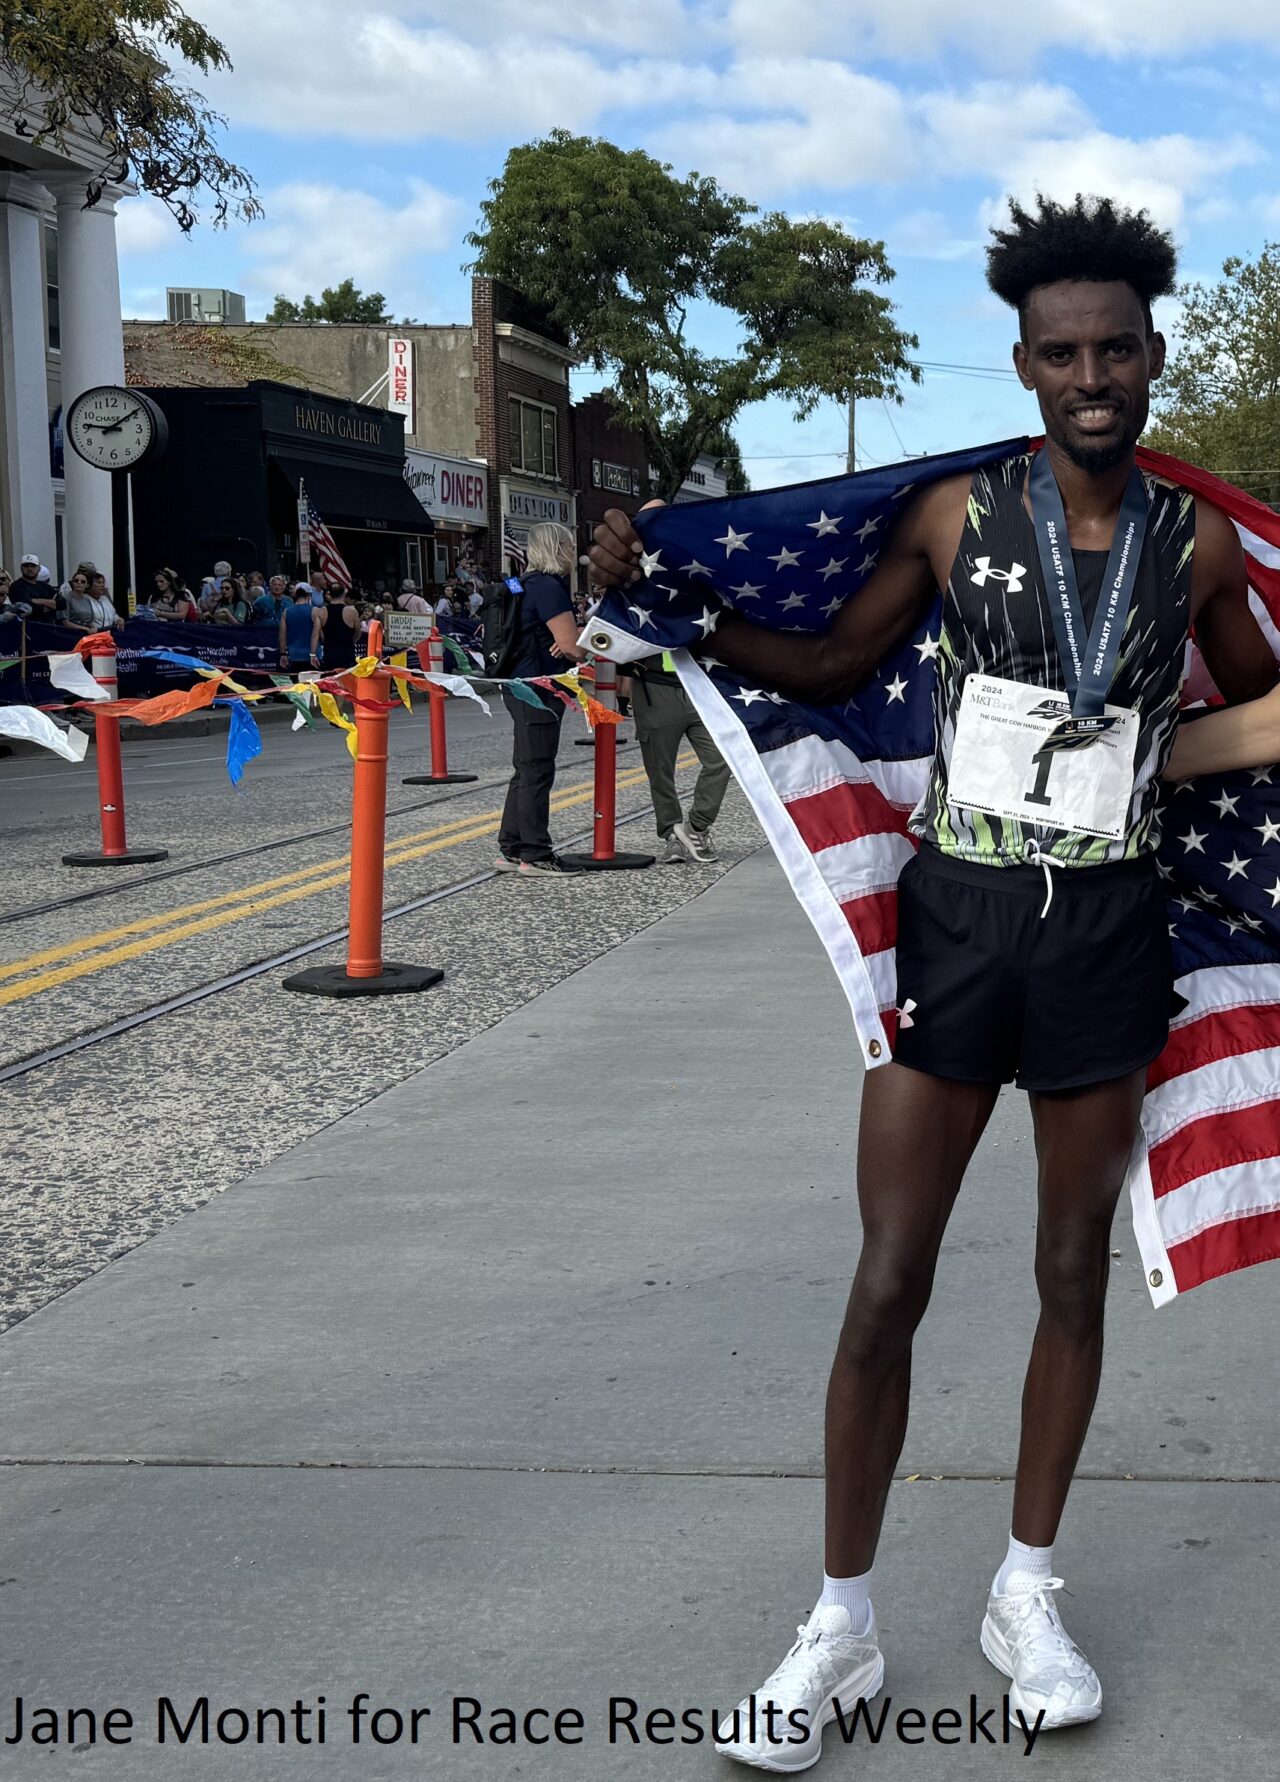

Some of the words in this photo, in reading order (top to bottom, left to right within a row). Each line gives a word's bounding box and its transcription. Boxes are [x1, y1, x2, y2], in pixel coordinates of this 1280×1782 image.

[394, 341, 407, 402] DINER
[95, 401, 102, 410] 11
[105, 397, 118, 408] 12
[123, 402, 127, 410] 1
[84, 411, 95, 420] 10
[135, 423, 143, 434] 3
[295, 405, 335, 436] HAVEN
[337, 415, 382, 445] GALLERY
[86, 438, 93, 446] 8
[135, 438, 141, 446] 4
[98, 446, 104, 455] 7
[110, 448, 118, 460] 6
[125, 448, 131, 456] 5
[441, 470, 484, 510] DINER
[1046, 521, 1058, 545] 2024
[1051, 547, 1064, 577] USATF
[1113, 521, 1135, 589] Championships
[1057, 580, 1067, 592] 10
[1060, 593, 1071, 609] KM
[1109, 590, 1120, 606] KM
[1106, 607, 1116, 619] 10
[1098, 620, 1112, 651] USATF
[1064, 611, 1083, 682] Championship
[1093, 651, 1105, 677] 2024
[981, 684, 1003, 695] 2024
[970, 693, 992, 707] M&T
[990, 715, 1008, 725] GREAT
[1008, 719, 1023, 727] COW
[1022, 722, 1046, 732] HARBOR
[1024, 750, 1054, 806] 1
